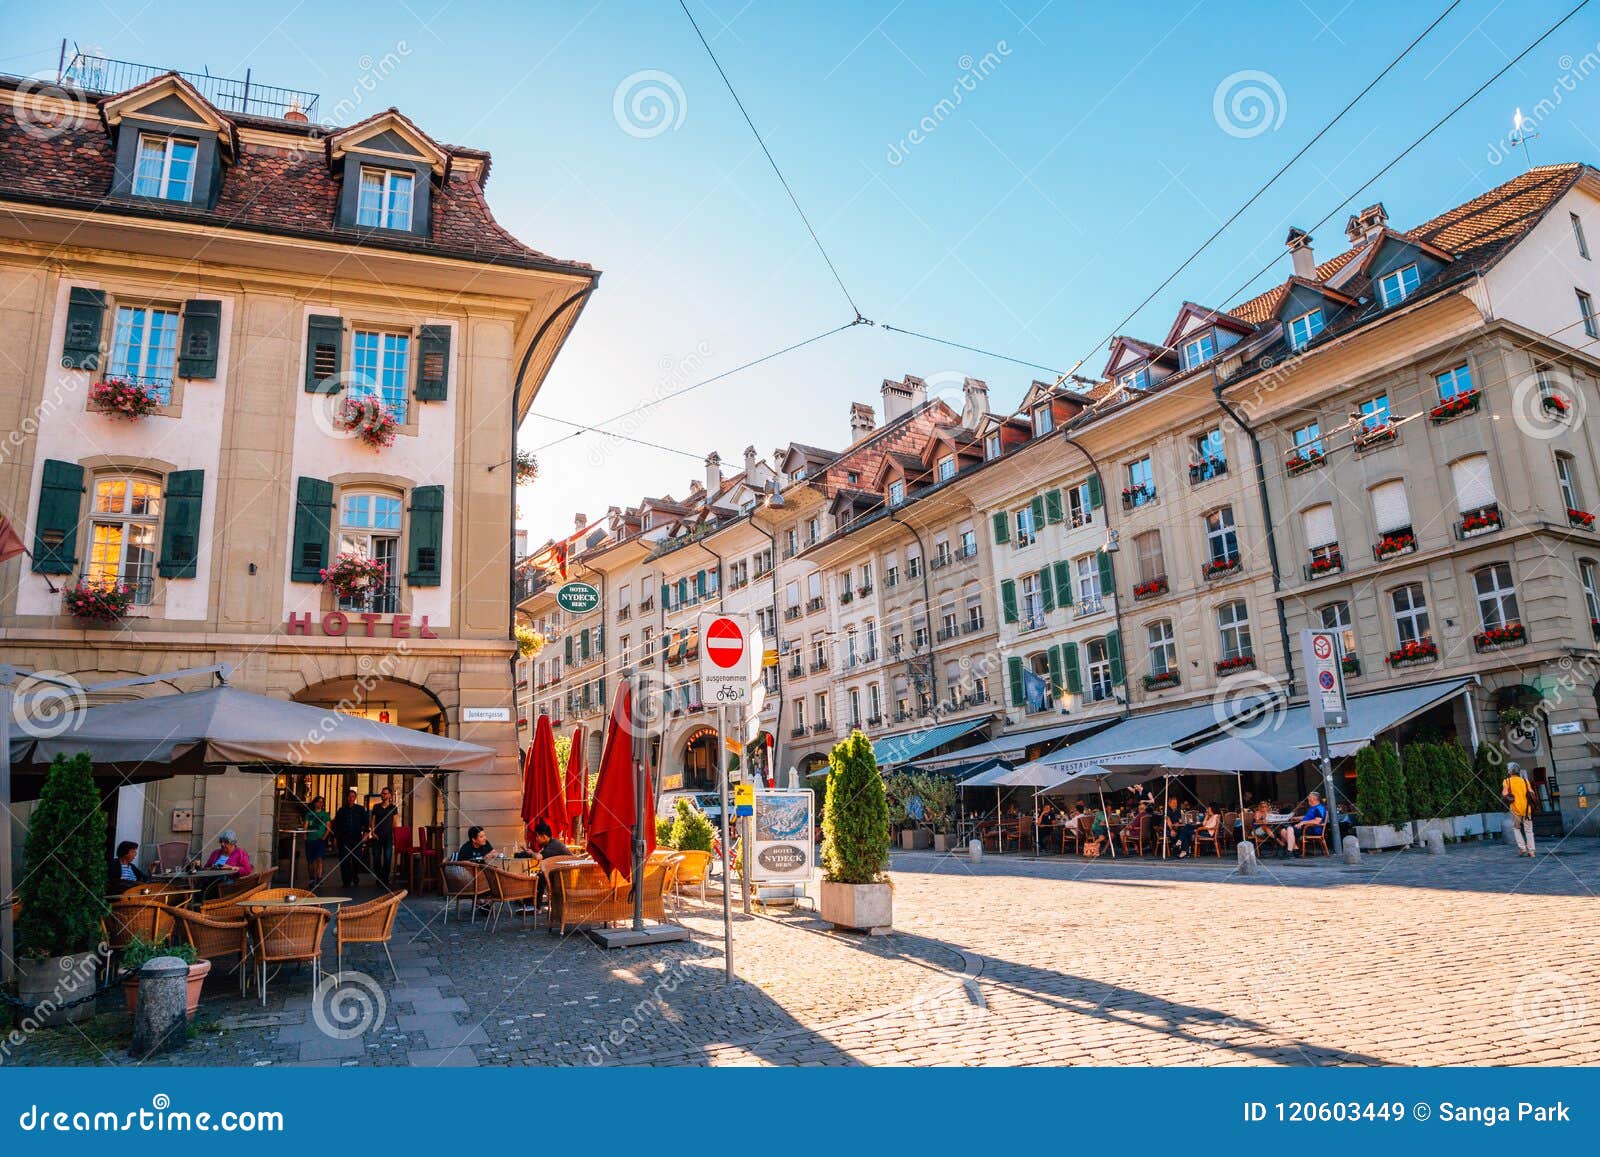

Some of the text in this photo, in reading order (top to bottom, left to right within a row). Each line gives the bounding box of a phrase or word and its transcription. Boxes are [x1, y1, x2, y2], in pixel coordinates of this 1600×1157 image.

[561, 593, 597, 602] NYDECK
[288, 611, 439, 639] HOTEL
[706, 675, 747, 683] ausgenommen
[765, 854, 802, 862] NYDECK
